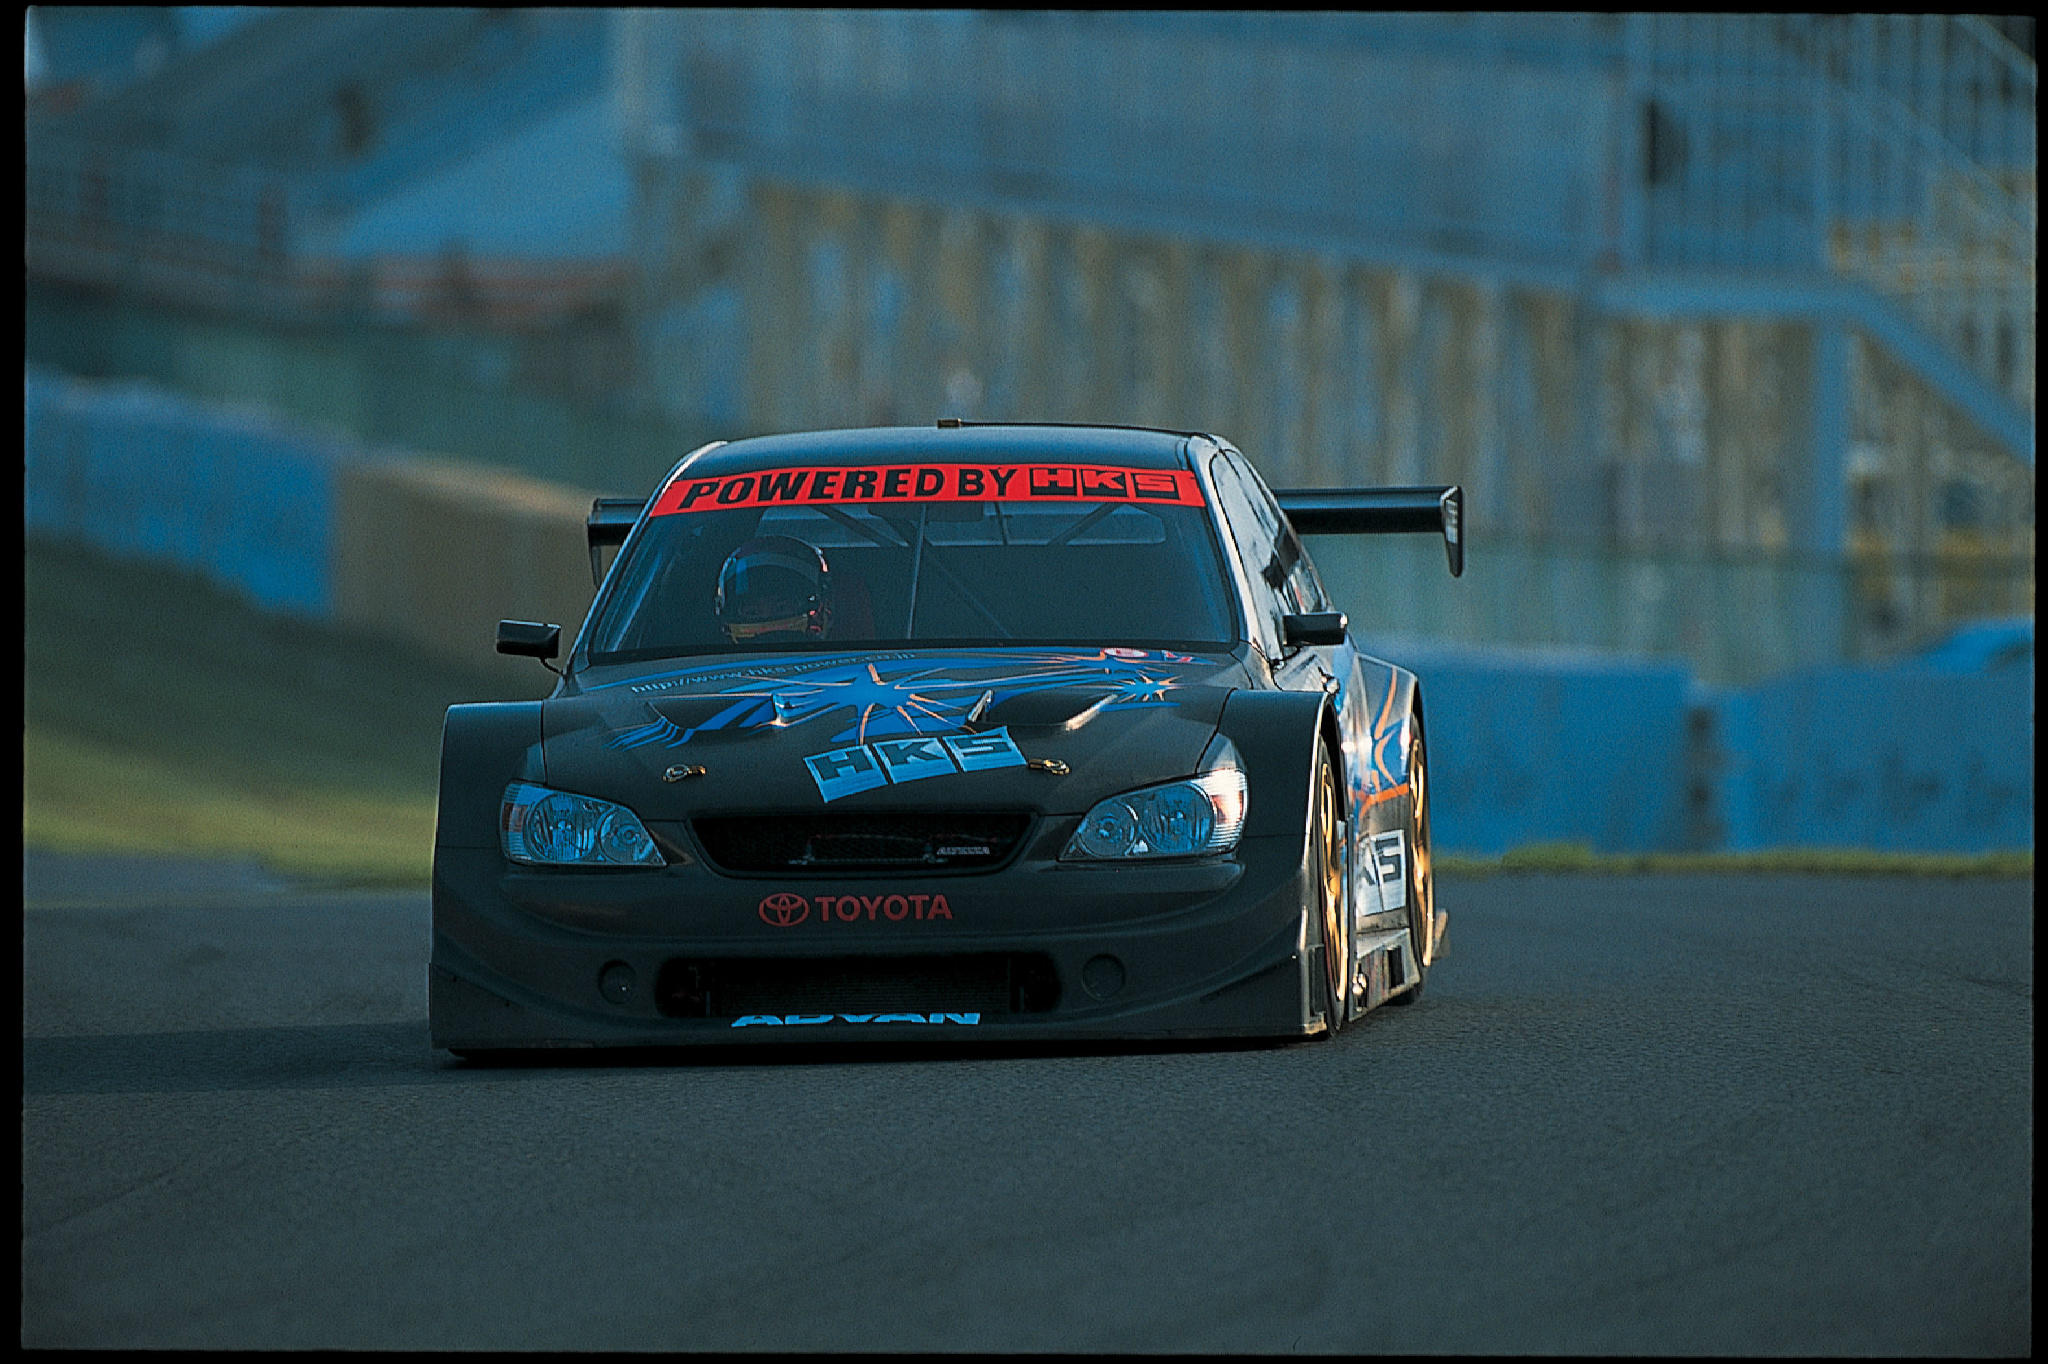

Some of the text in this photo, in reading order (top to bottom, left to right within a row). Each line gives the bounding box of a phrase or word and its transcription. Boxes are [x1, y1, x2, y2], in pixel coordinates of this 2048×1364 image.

[677, 468, 1179, 510] POWERED BY HKS
[809, 731, 1017, 785] HKS
[815, 895, 952, 921] TOYOTA
